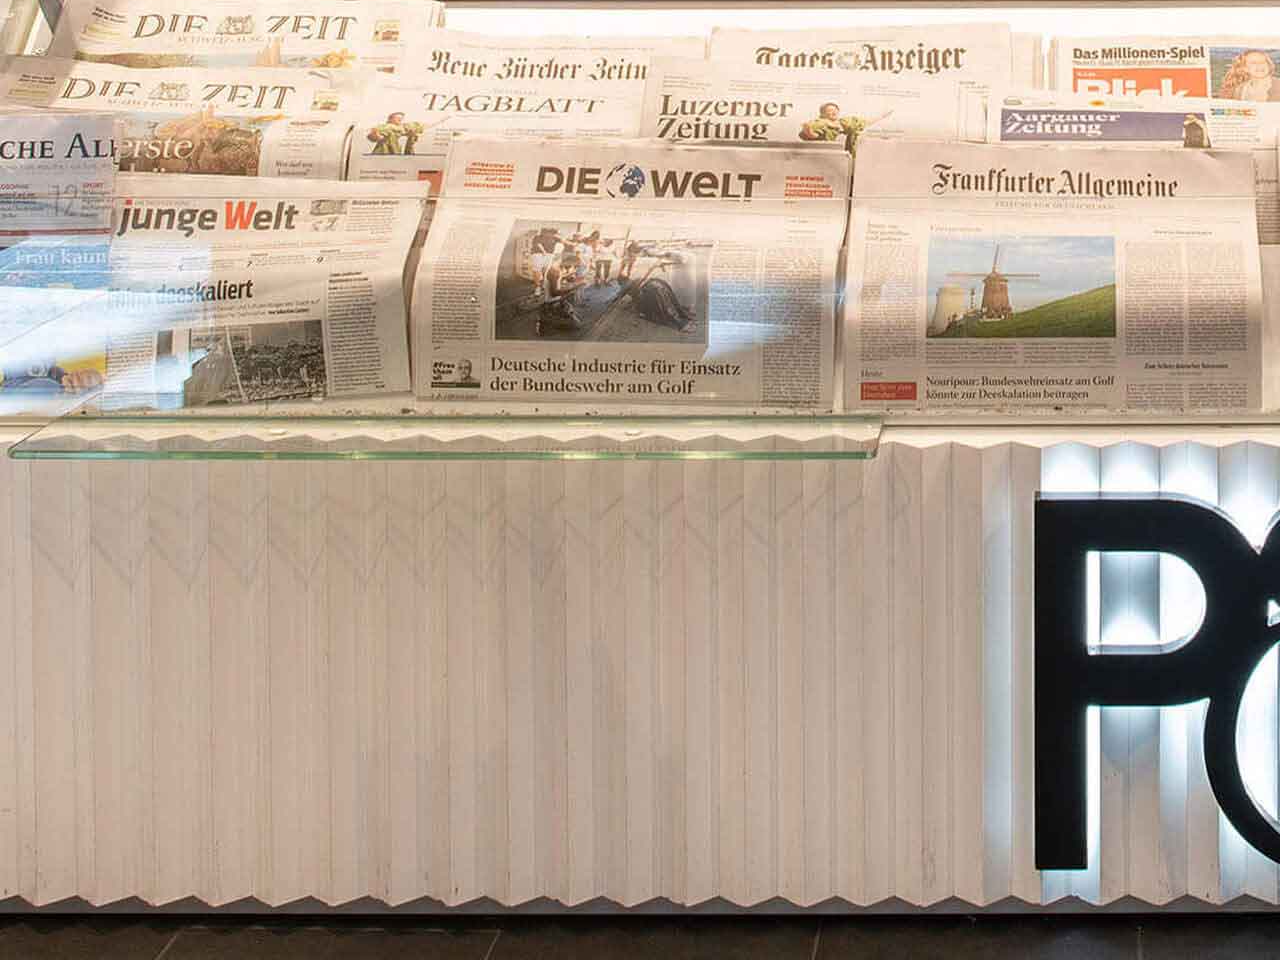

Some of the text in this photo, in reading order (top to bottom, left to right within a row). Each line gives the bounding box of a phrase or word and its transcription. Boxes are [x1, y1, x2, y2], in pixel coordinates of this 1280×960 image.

[133, 13, 358, 40] DIE ZEIT
[428, 50, 583, 81] Neue Zürcher
[857, 42, 967, 75] Anzeiger
[1073, 46, 1205, 61] Das Millionen-Spiel
[61, 77, 297, 110] DIE ZEIT
[422, 92, 604, 114] TAGBLATT
[658, 93, 794, 118] Luzerner
[656, 117, 769, 141] Zeitung
[1004, 120, 1103, 137] Zeitung
[535, 166, 602, 195] DIE
[931, 162, 1179, 199] Frankfurter Allgemeine
[117, 198, 218, 238] junge
[223, 199, 299, 231] Welt
[489, 357, 741, 377] Deutsche Industrie für Einsatz
[489, 378, 696, 396] der Bundeswehr am Golf
[926, 375, 979, 390] Nouripour:
[1075, 378, 1090, 388] am
[1092, 374, 1115, 389] Golf
[926, 390, 956, 401] könnte
[957, 391, 976, 401] zur
